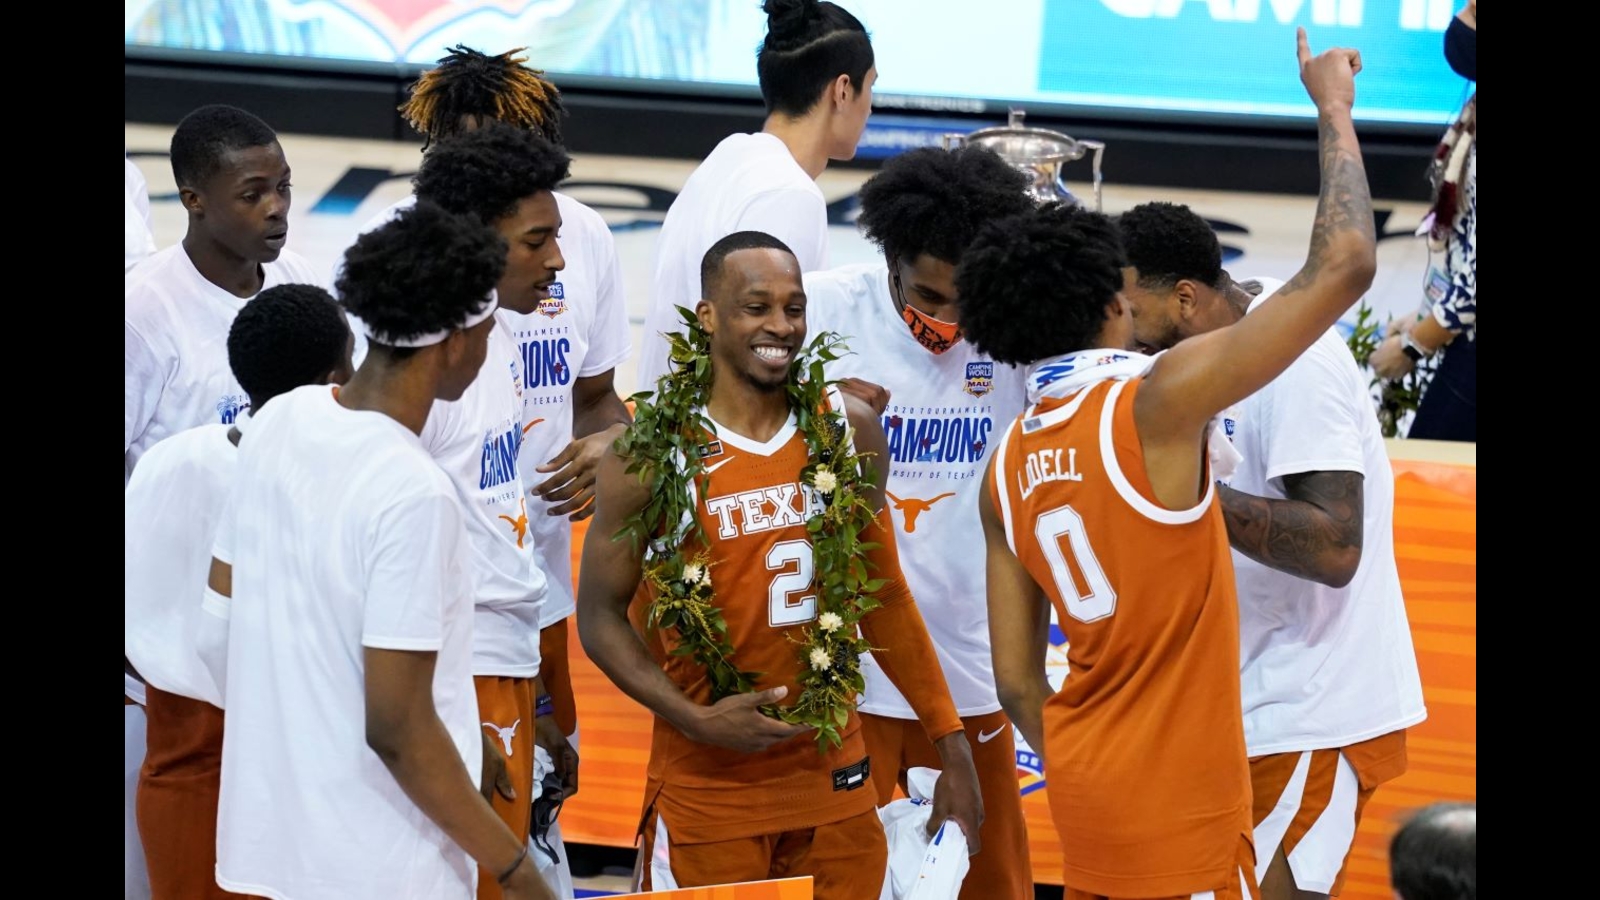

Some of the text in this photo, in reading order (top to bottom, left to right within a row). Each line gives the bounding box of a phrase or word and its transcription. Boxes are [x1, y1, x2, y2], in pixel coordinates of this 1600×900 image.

[518, 338, 570, 389] IONS
[534, 394, 564, 406] TEXAS
[885, 404, 992, 415] 2020 TOURNAMENT
[892, 470, 923, 479] RSITY
[929, 471, 941, 480] OF
[705, 481, 828, 540] TEXA
[1035, 504, 1118, 624] 0
[765, 538, 818, 628] 2
[1018, 754, 1040, 767] DE
